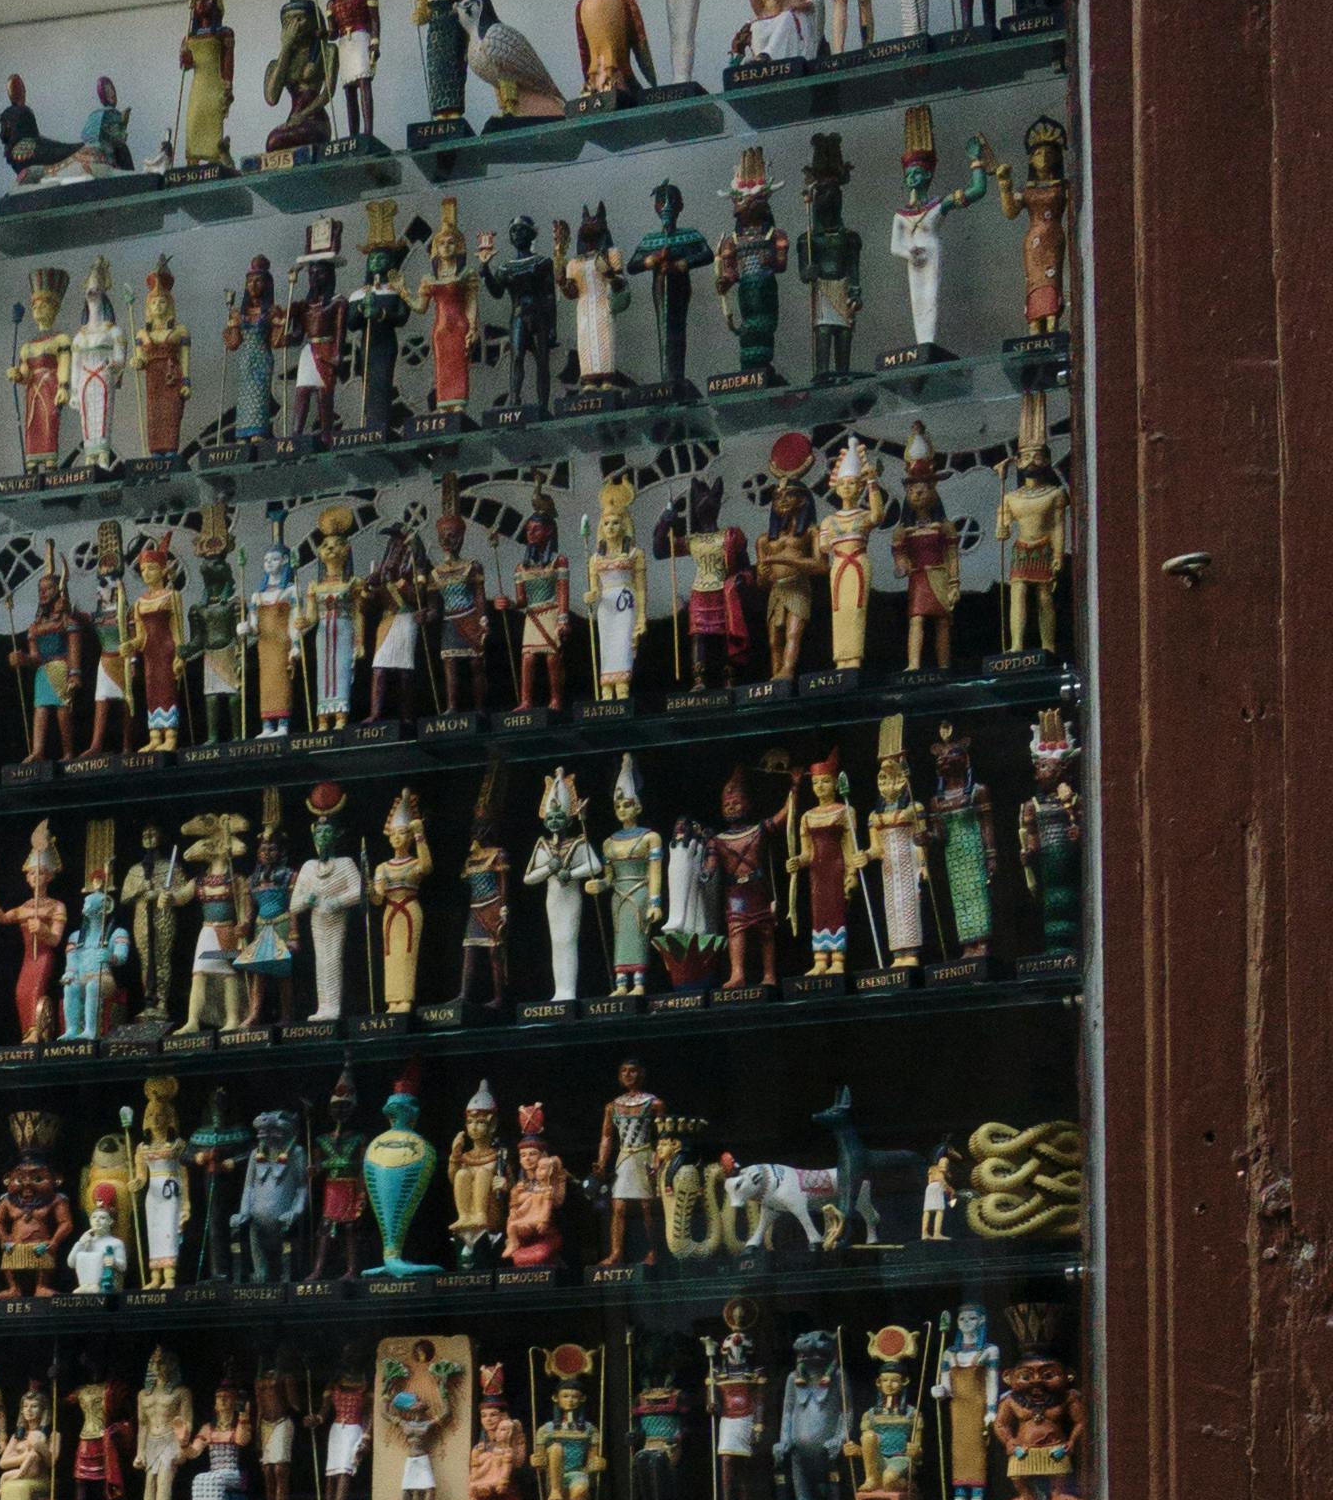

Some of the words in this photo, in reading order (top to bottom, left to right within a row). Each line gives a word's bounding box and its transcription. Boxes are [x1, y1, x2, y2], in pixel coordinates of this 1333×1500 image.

[732, 63, 790, 82] SERAPIS
[324, 138, 357, 155] SETH
[884, 349, 917, 365] MIN
[499, 410, 521, 424] IHY
[415, 419, 445, 432] ISIS
[277, 441, 294, 453] KA
[809, 674, 843, 689] ANAT
[749, 684, 773, 698] IAH
[355, 726, 386, 739] THOT
[425, 718, 468, 734] AMON
[423, 1008, 454, 1021] AMON
[524, 1004, 566, 1017] OSIRIS
[360, 1018, 395, 1032] ANAT
[593, 1269, 634, 1282] ANTY
[6, 1303, 32, 1314] BES
